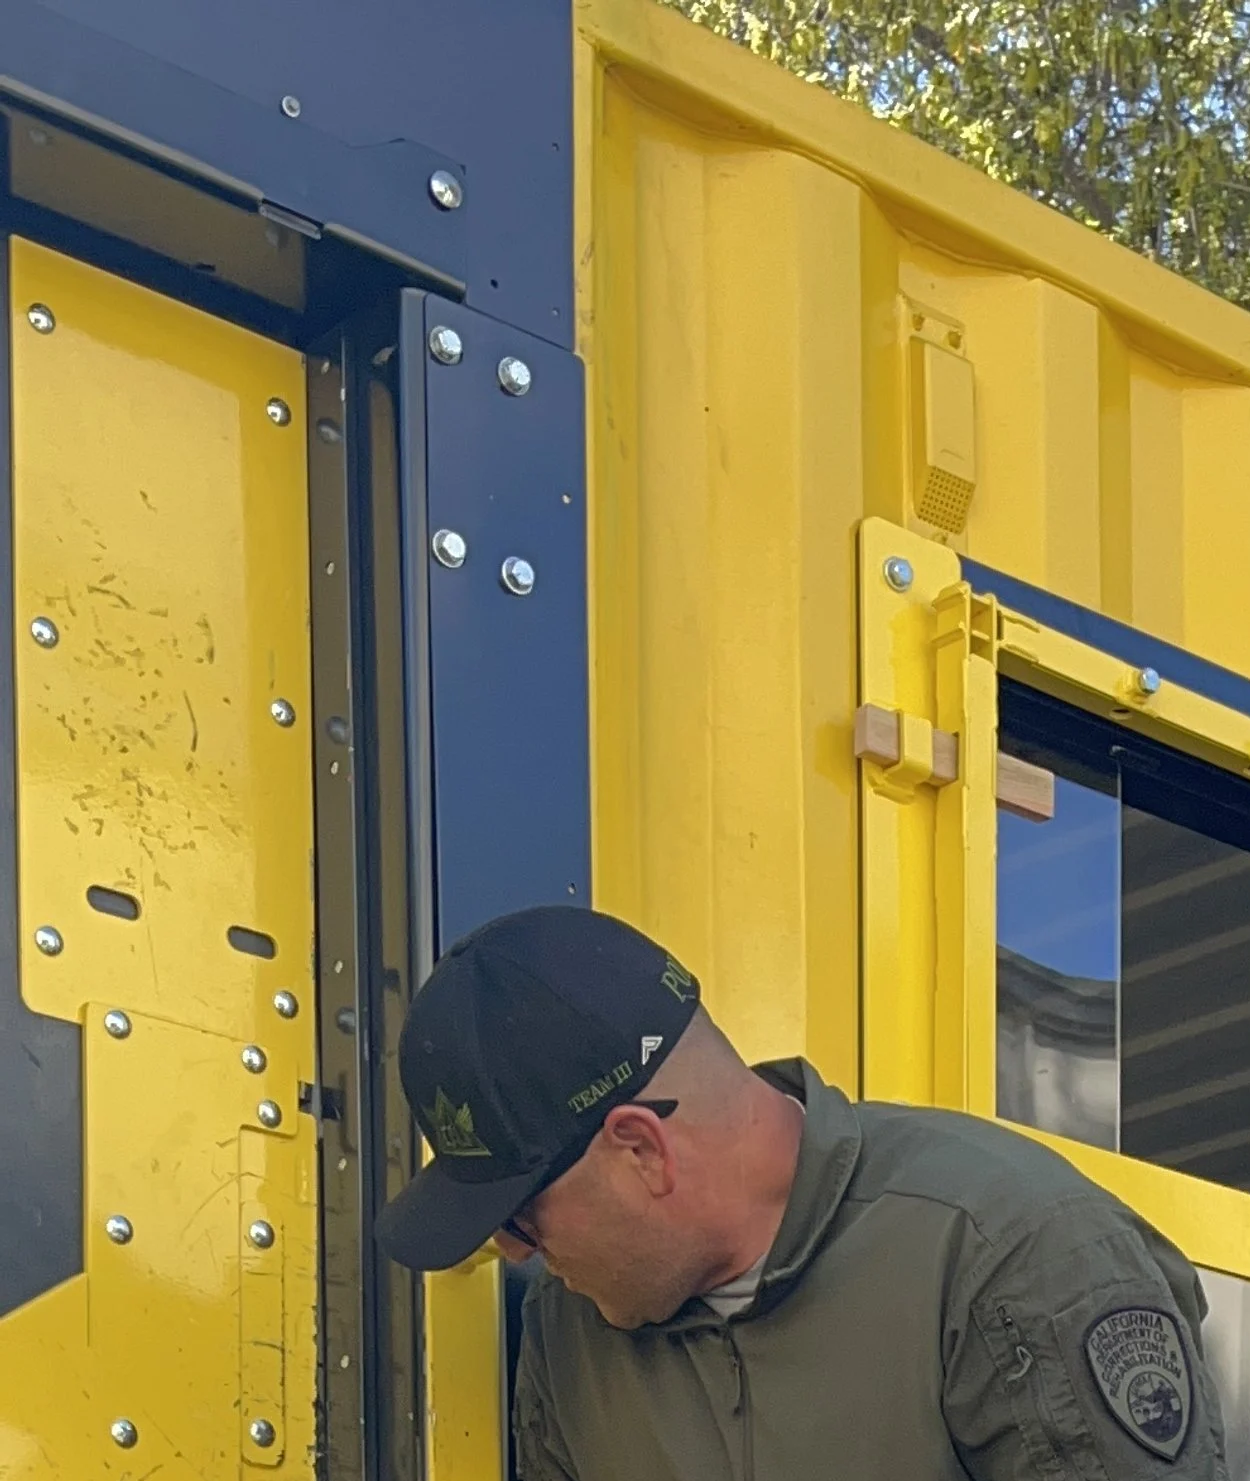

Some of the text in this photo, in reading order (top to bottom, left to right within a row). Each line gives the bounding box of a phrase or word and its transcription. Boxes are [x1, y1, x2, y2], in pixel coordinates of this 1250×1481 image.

[567, 1061, 633, 1113] TEAM III
[1091, 1312, 1163, 1351] CALIFORNIA
[1096, 1328, 1169, 1365] DEPARTMENT OF
[1102, 1341, 1167, 1383] CORRECTIONS
[1109, 1353, 1182, 1400] REHABILITATION
